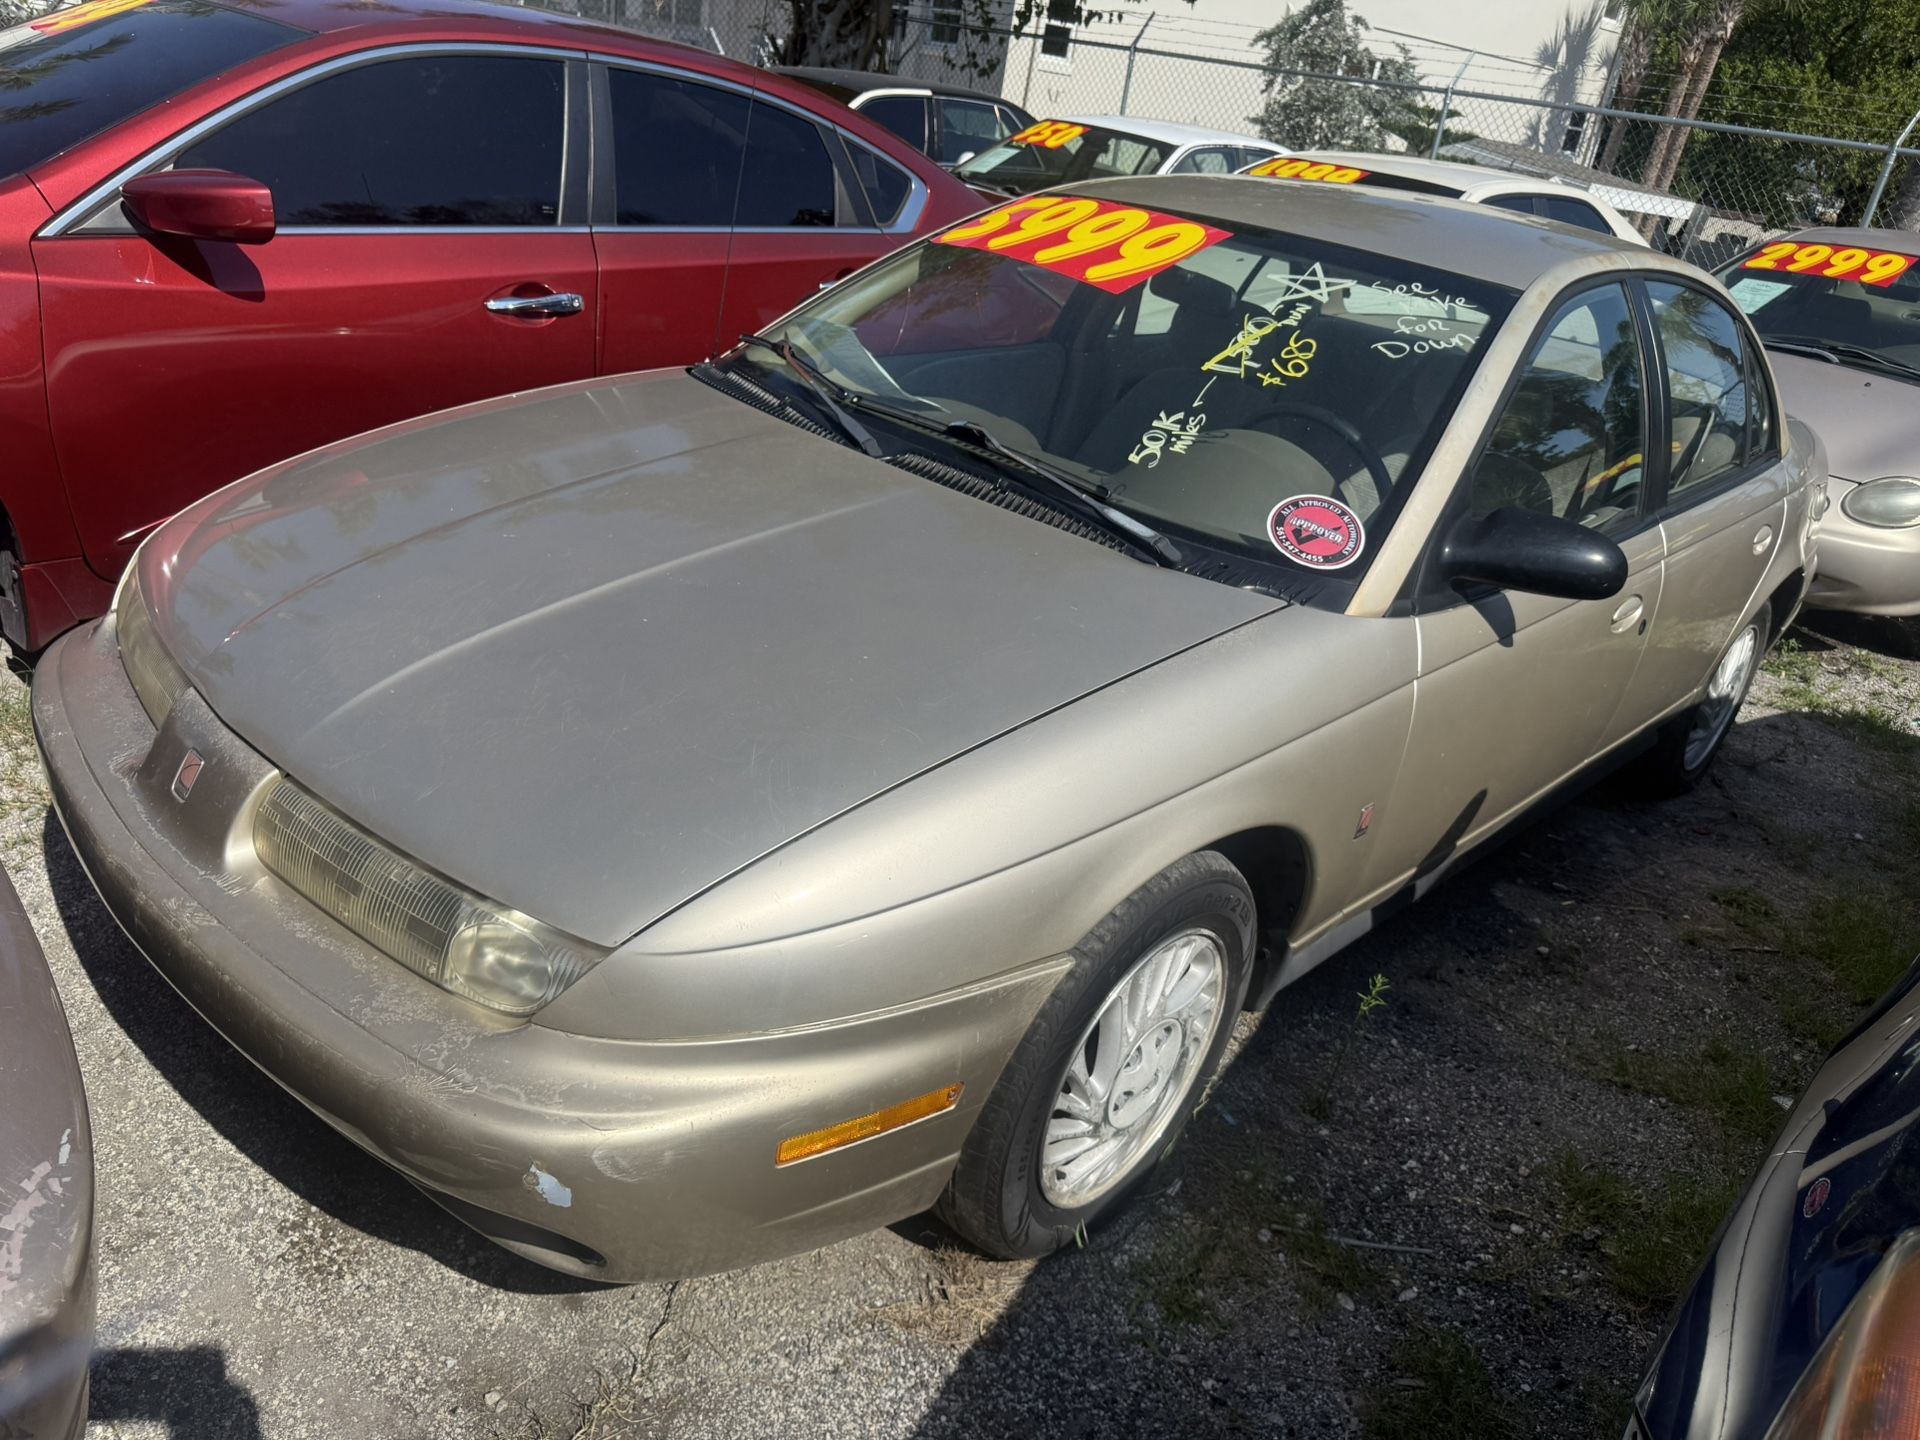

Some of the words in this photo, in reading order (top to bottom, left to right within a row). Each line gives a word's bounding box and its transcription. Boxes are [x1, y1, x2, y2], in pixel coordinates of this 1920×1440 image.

[940, 197, 1207, 283] 5999
[1745, 242, 1909, 284] 2999
[1128, 410, 1185, 468] 50K
[1298, 500, 1342, 515] APPROVED
[1289, 516, 1345, 545] APPROVED
